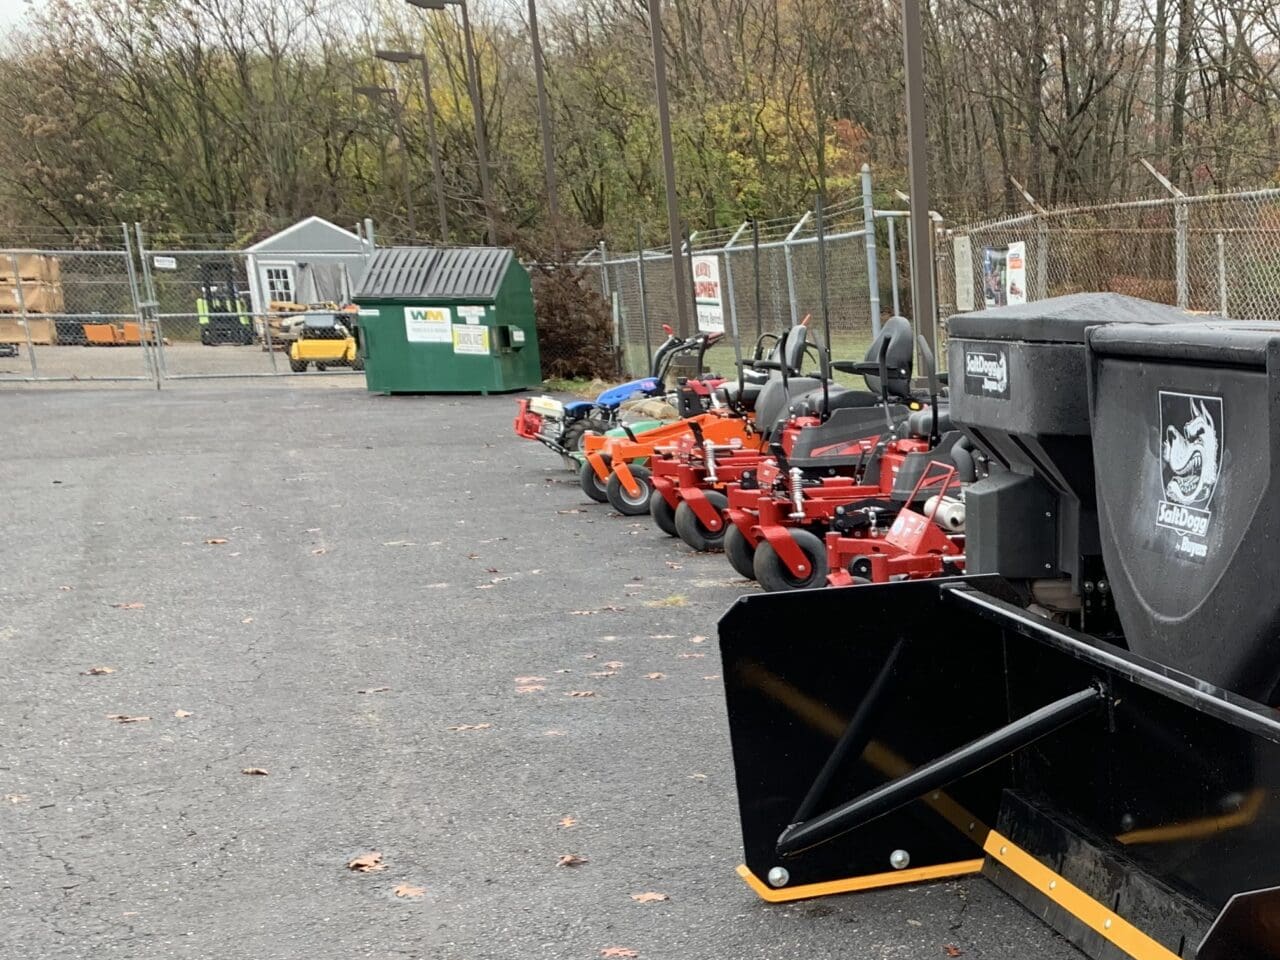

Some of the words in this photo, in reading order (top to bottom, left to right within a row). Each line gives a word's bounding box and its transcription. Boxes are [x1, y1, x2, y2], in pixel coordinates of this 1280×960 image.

[411, 310, 445, 321] WM
[967, 354, 1000, 377] SaltDogg
[1158, 503, 1208, 535] SaltDogg
